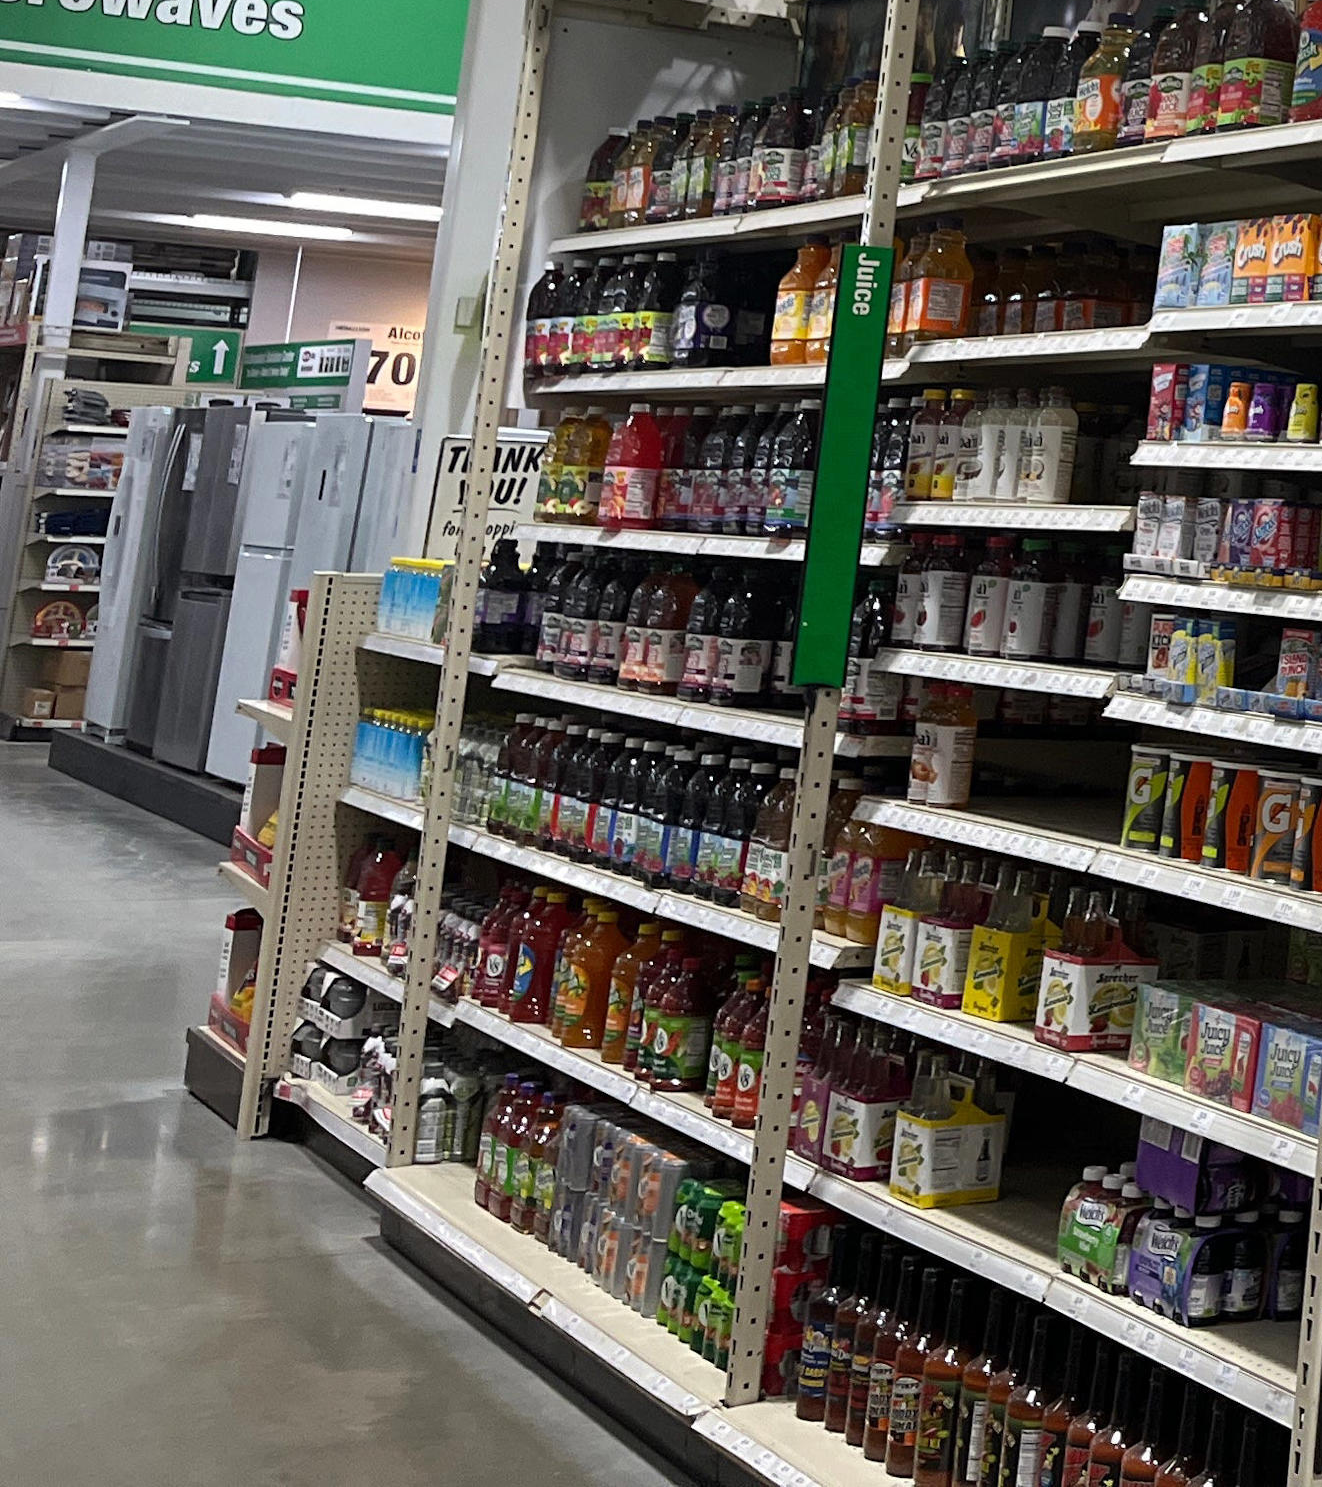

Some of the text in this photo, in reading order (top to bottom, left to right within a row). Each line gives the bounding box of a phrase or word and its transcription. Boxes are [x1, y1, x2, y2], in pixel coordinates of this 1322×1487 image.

[1272, 230, 1303, 267] Crush
[852, 252, 881, 317] Juice
[448, 446, 545, 473] TNK
